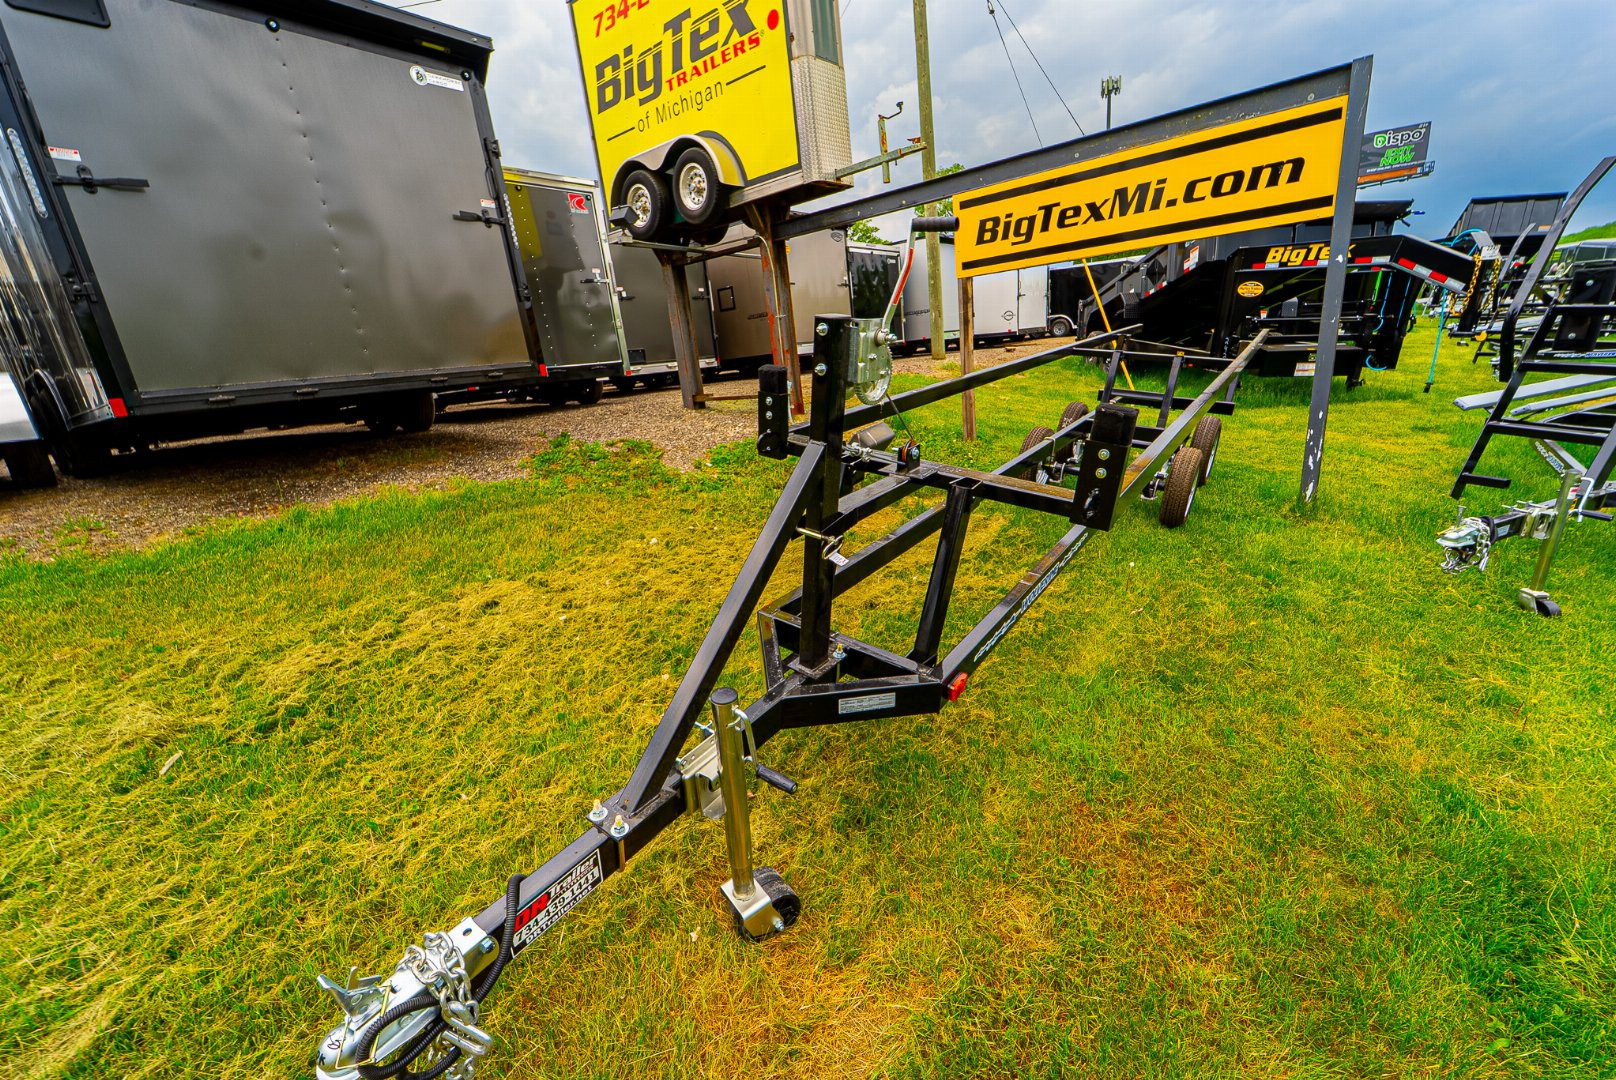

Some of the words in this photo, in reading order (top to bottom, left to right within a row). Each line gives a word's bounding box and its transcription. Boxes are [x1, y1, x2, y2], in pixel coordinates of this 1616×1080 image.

[595, 0, 756, 115] BigTex
[665, 32, 760, 92] TRAILERS
[637, 110, 650, 132] of
[656, 81, 723, 125] Michigan
[974, 156, 1306, 247] BigTexMi.com
[515, 870, 600, 943] 734-439-1441
